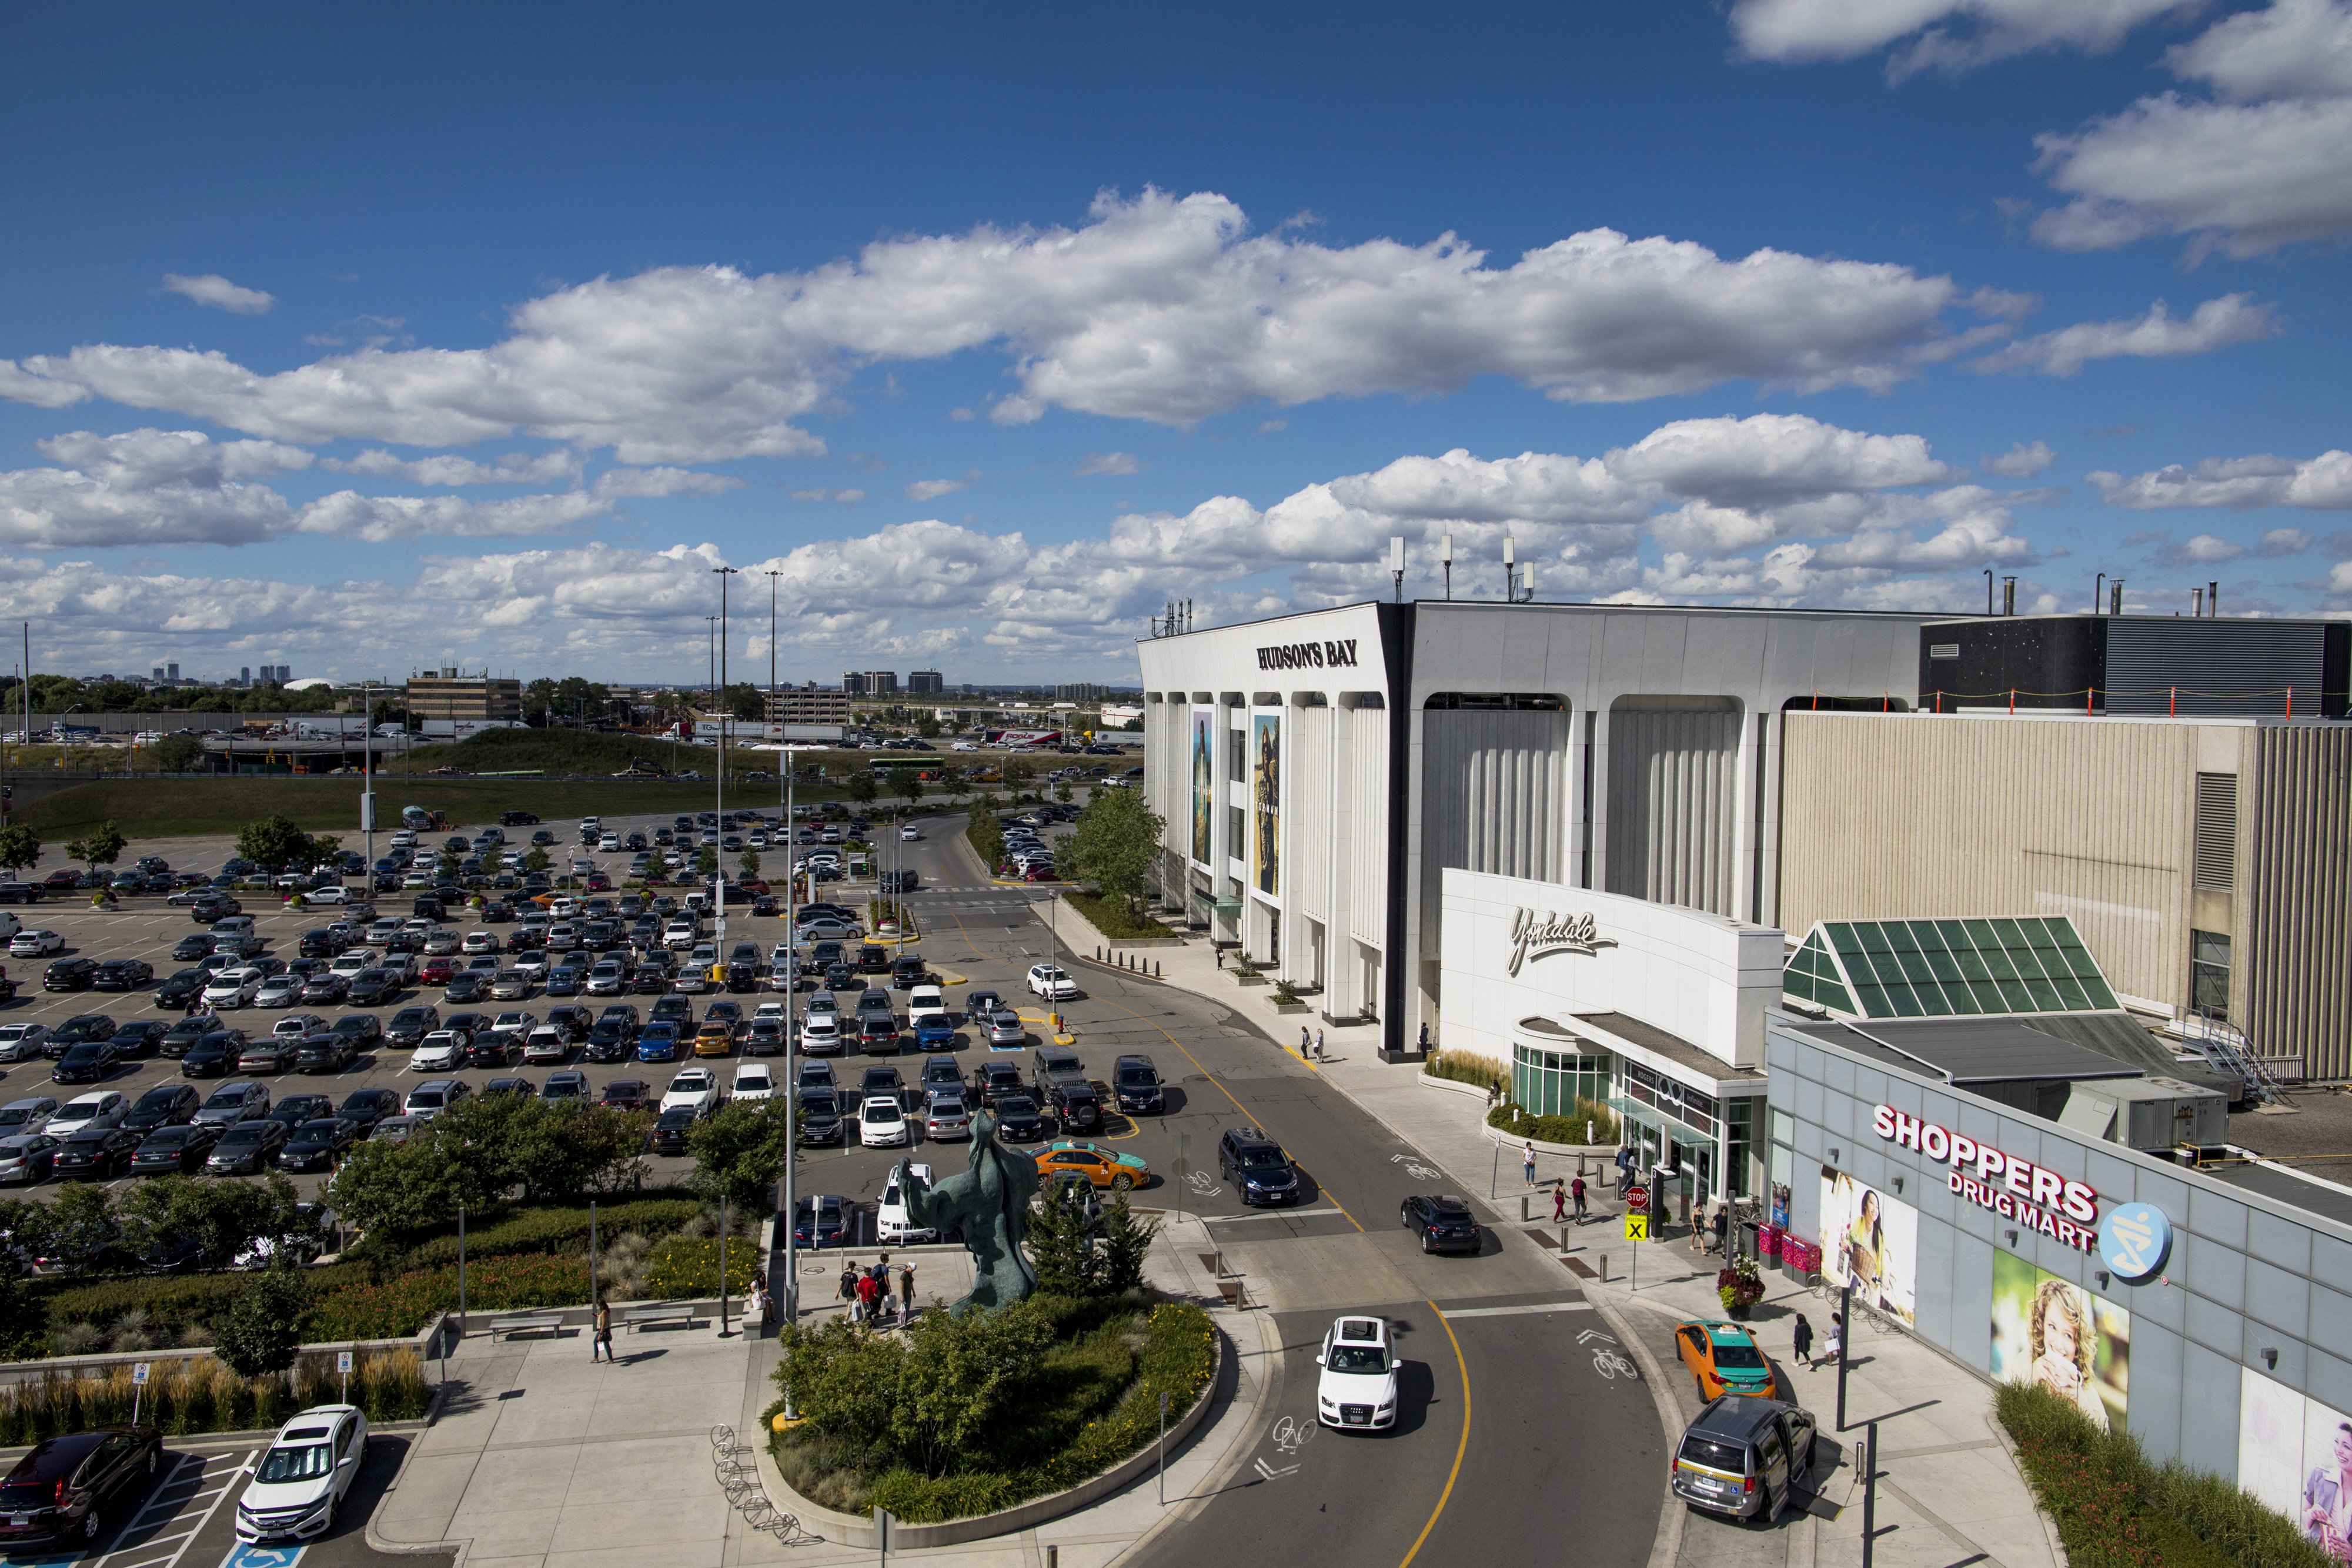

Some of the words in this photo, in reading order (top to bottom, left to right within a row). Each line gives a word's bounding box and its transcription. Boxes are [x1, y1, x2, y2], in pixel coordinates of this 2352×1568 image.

[1257, 642, 1322, 670] HUDSON'S
[1324, 639, 1357, 666] BAY
[1255, 801, 1278, 815] TOPMAN
[1506, 906, 1618, 974] Yorkdale
[1638, 1071, 1654, 1084] ROGERS
[1687, 1094, 1703, 1107] Infinite
[1657, 1124, 1668, 1169] J
[1872, 1105, 2098, 1222] SHOPPERS
[1653, 1170, 1656, 1178] 3
[1628, 1193, 1646, 1201] STOP
[1947, 1170, 2016, 1216] DRUG
[2017, 1200, 2097, 1251] MART
[1629, 1223, 1642, 1238] X
